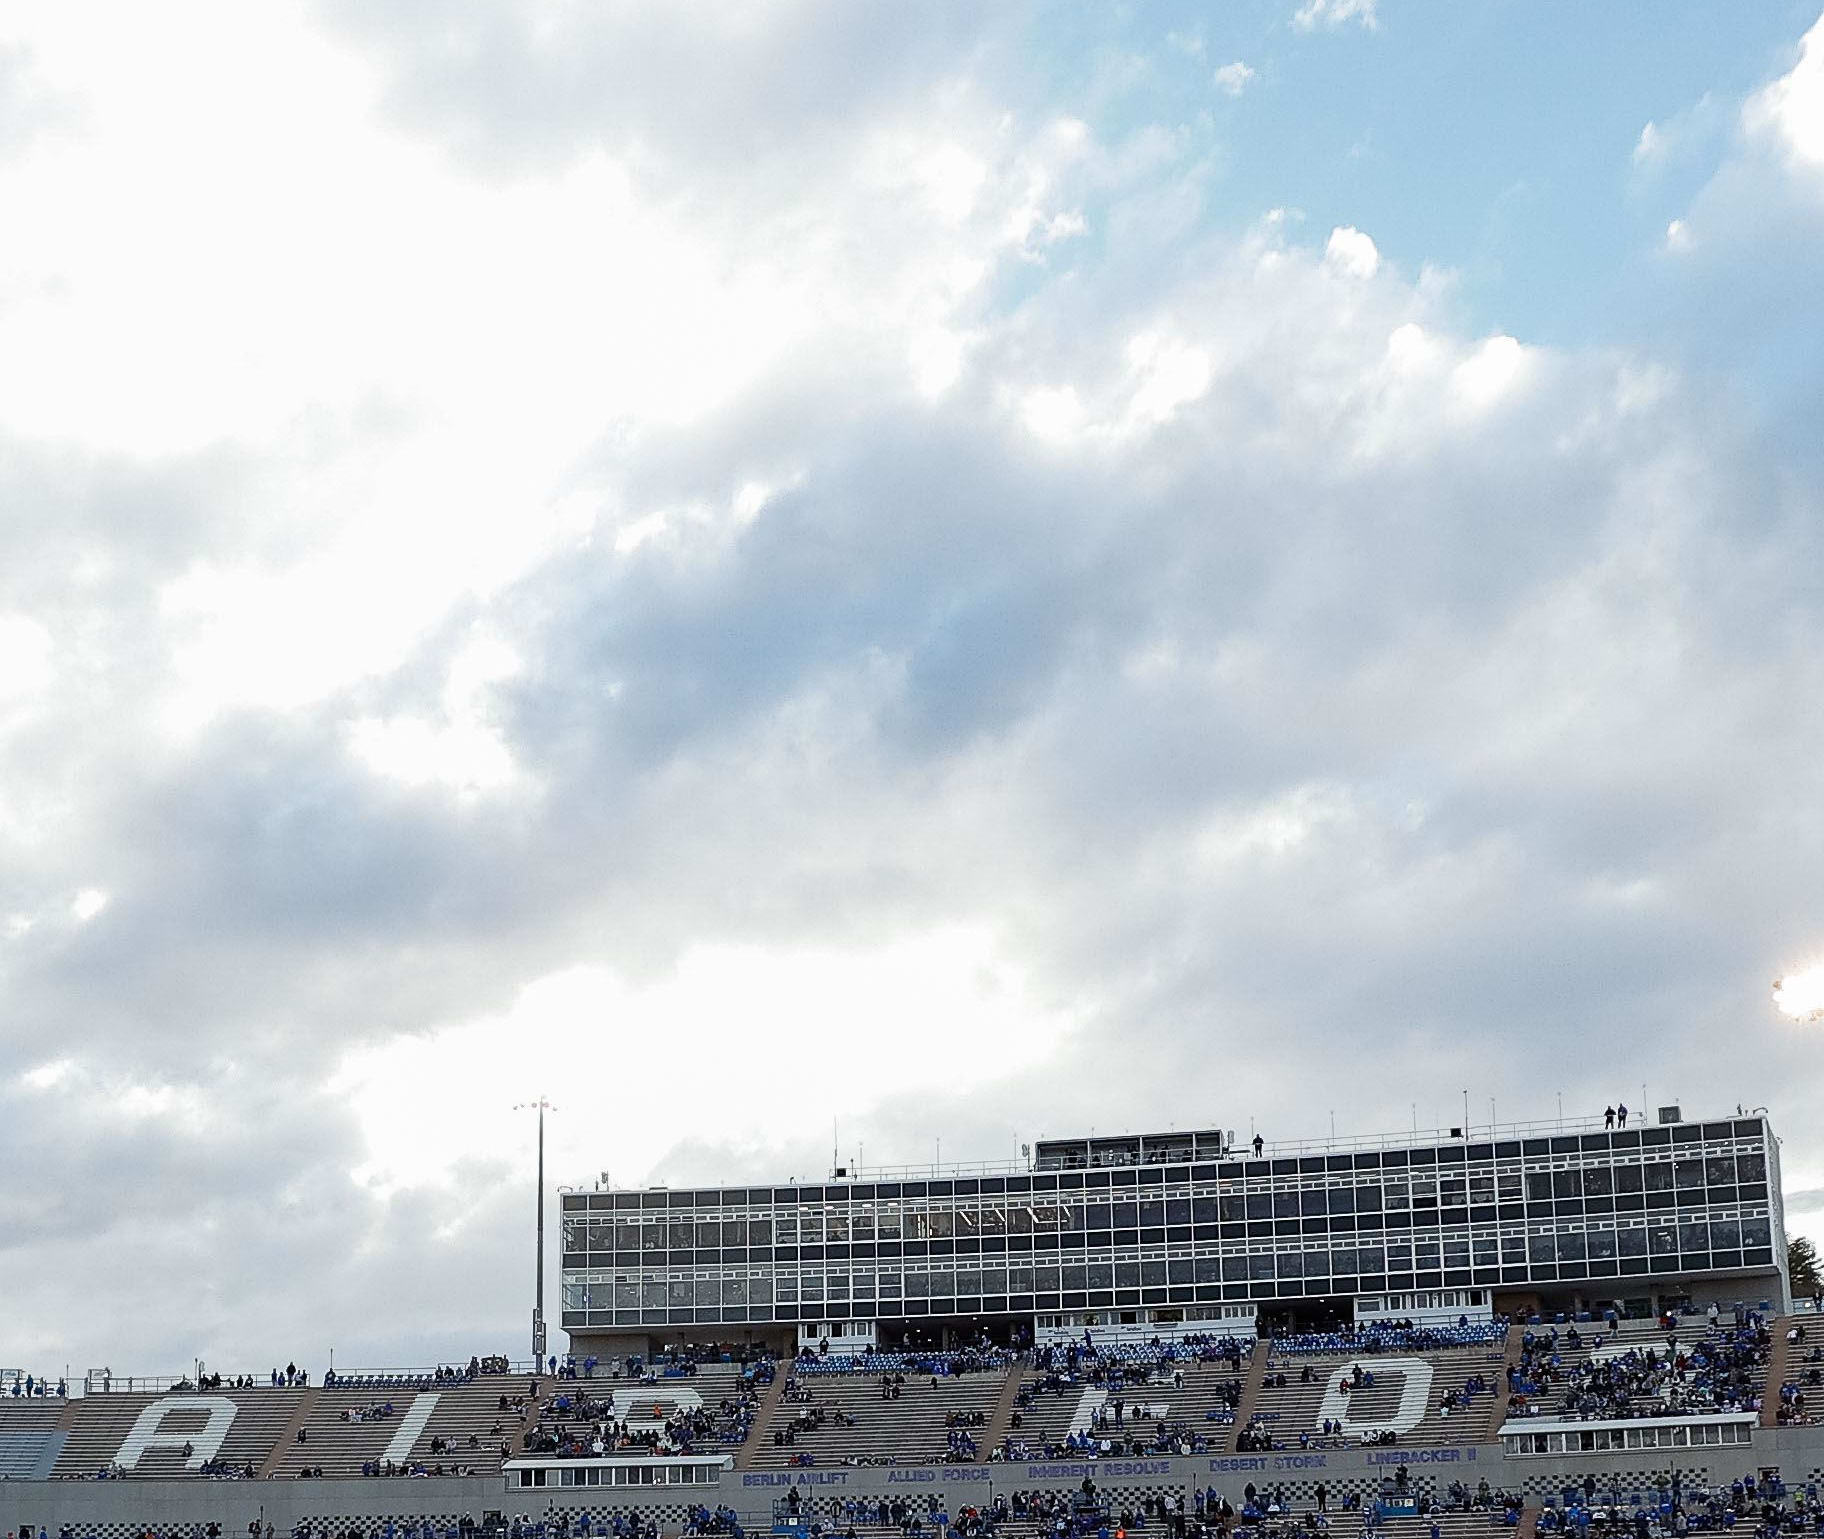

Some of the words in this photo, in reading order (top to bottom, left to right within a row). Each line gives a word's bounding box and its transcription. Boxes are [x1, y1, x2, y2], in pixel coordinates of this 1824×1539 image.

[1209, 1457, 1268, 1473] DESERT
[1276, 1454, 1327, 1470] STORM
[1367, 1449, 1460, 1466] LINEBACKER
[887, 1470, 936, 1484] ALLIED
[942, 1468, 991, 1482] FORCE
[1028, 1465, 1098, 1479] INHERENT
[1104, 1461, 1170, 1476] RESOLVE
[743, 1474, 791, 1487] BERLIN
[797, 1472, 849, 1486] AIRLIFT
